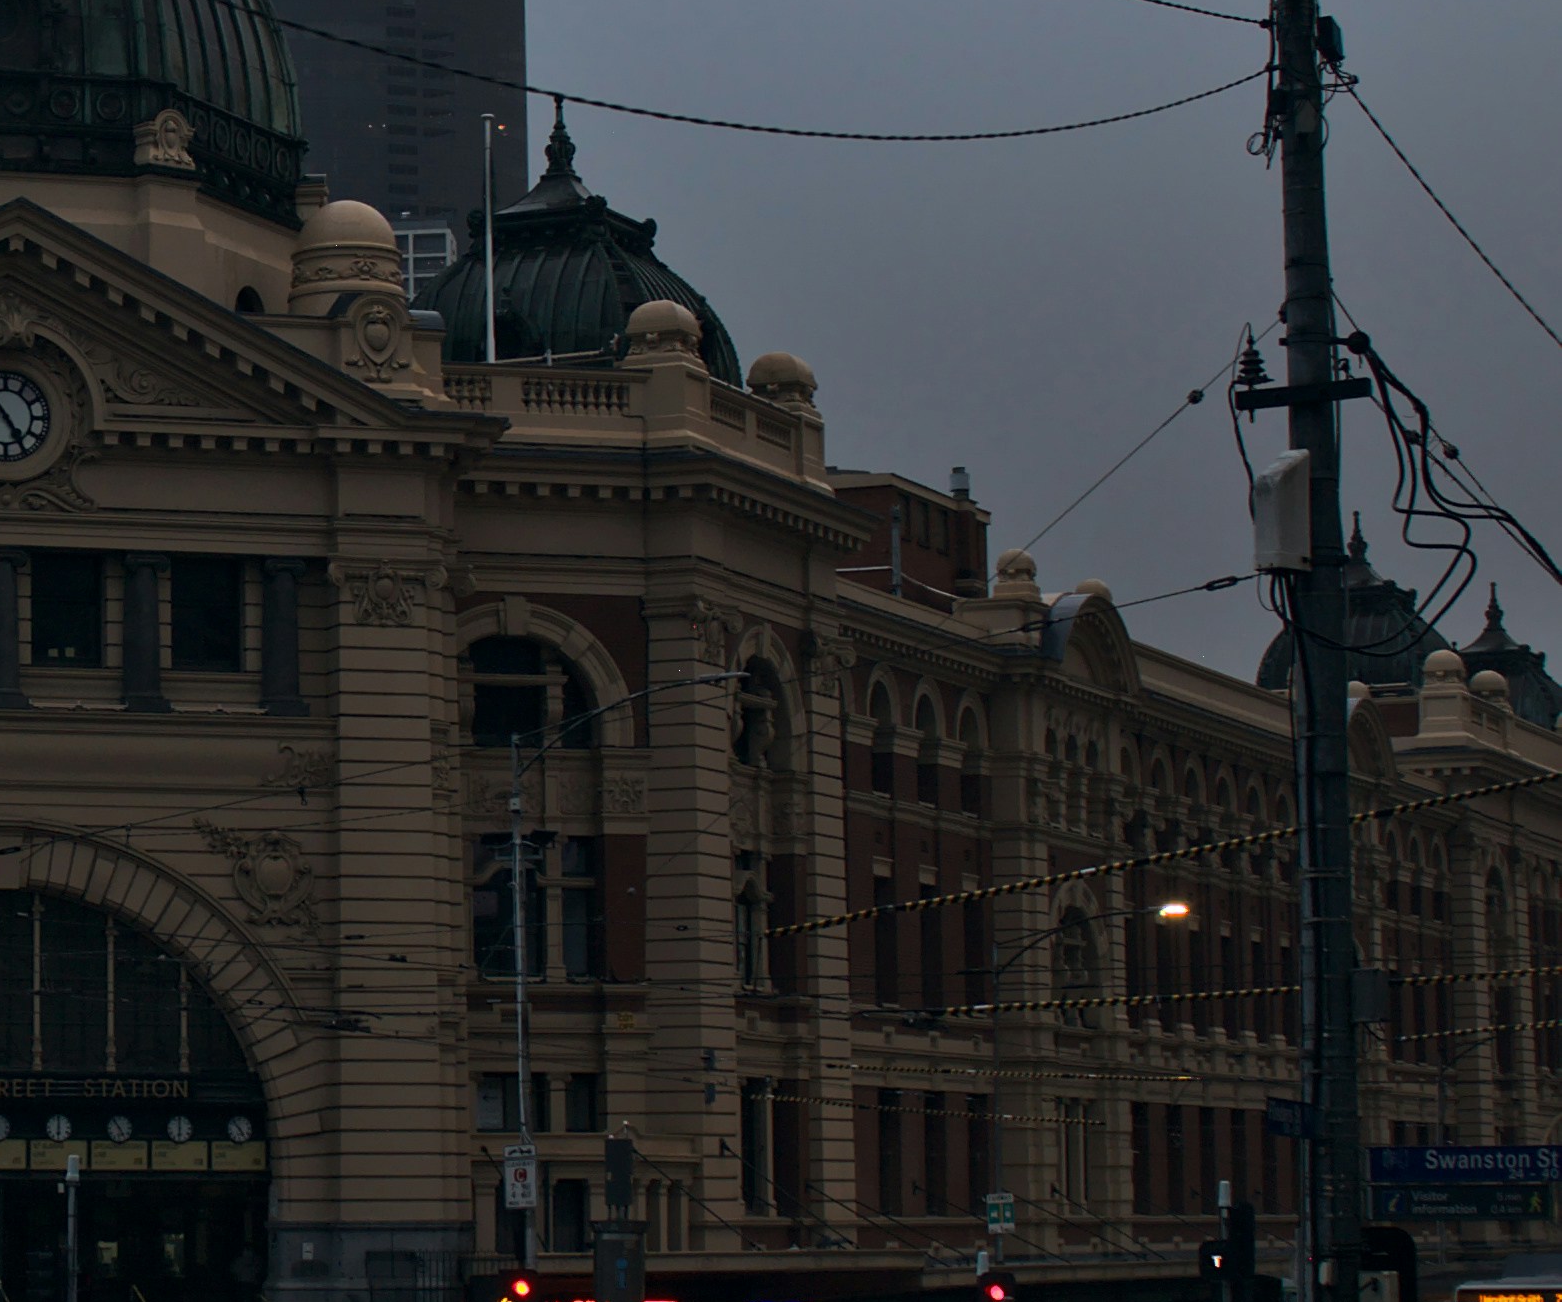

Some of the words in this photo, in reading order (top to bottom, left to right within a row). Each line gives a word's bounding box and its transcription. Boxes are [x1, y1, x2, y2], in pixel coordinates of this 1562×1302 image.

[83, 1079, 189, 1098] STATION
[1424, 1148, 1531, 1170] Swanston
[1536, 1147, 1559, 1169] St
[1411, 1190, 1449, 1202] Visitor
